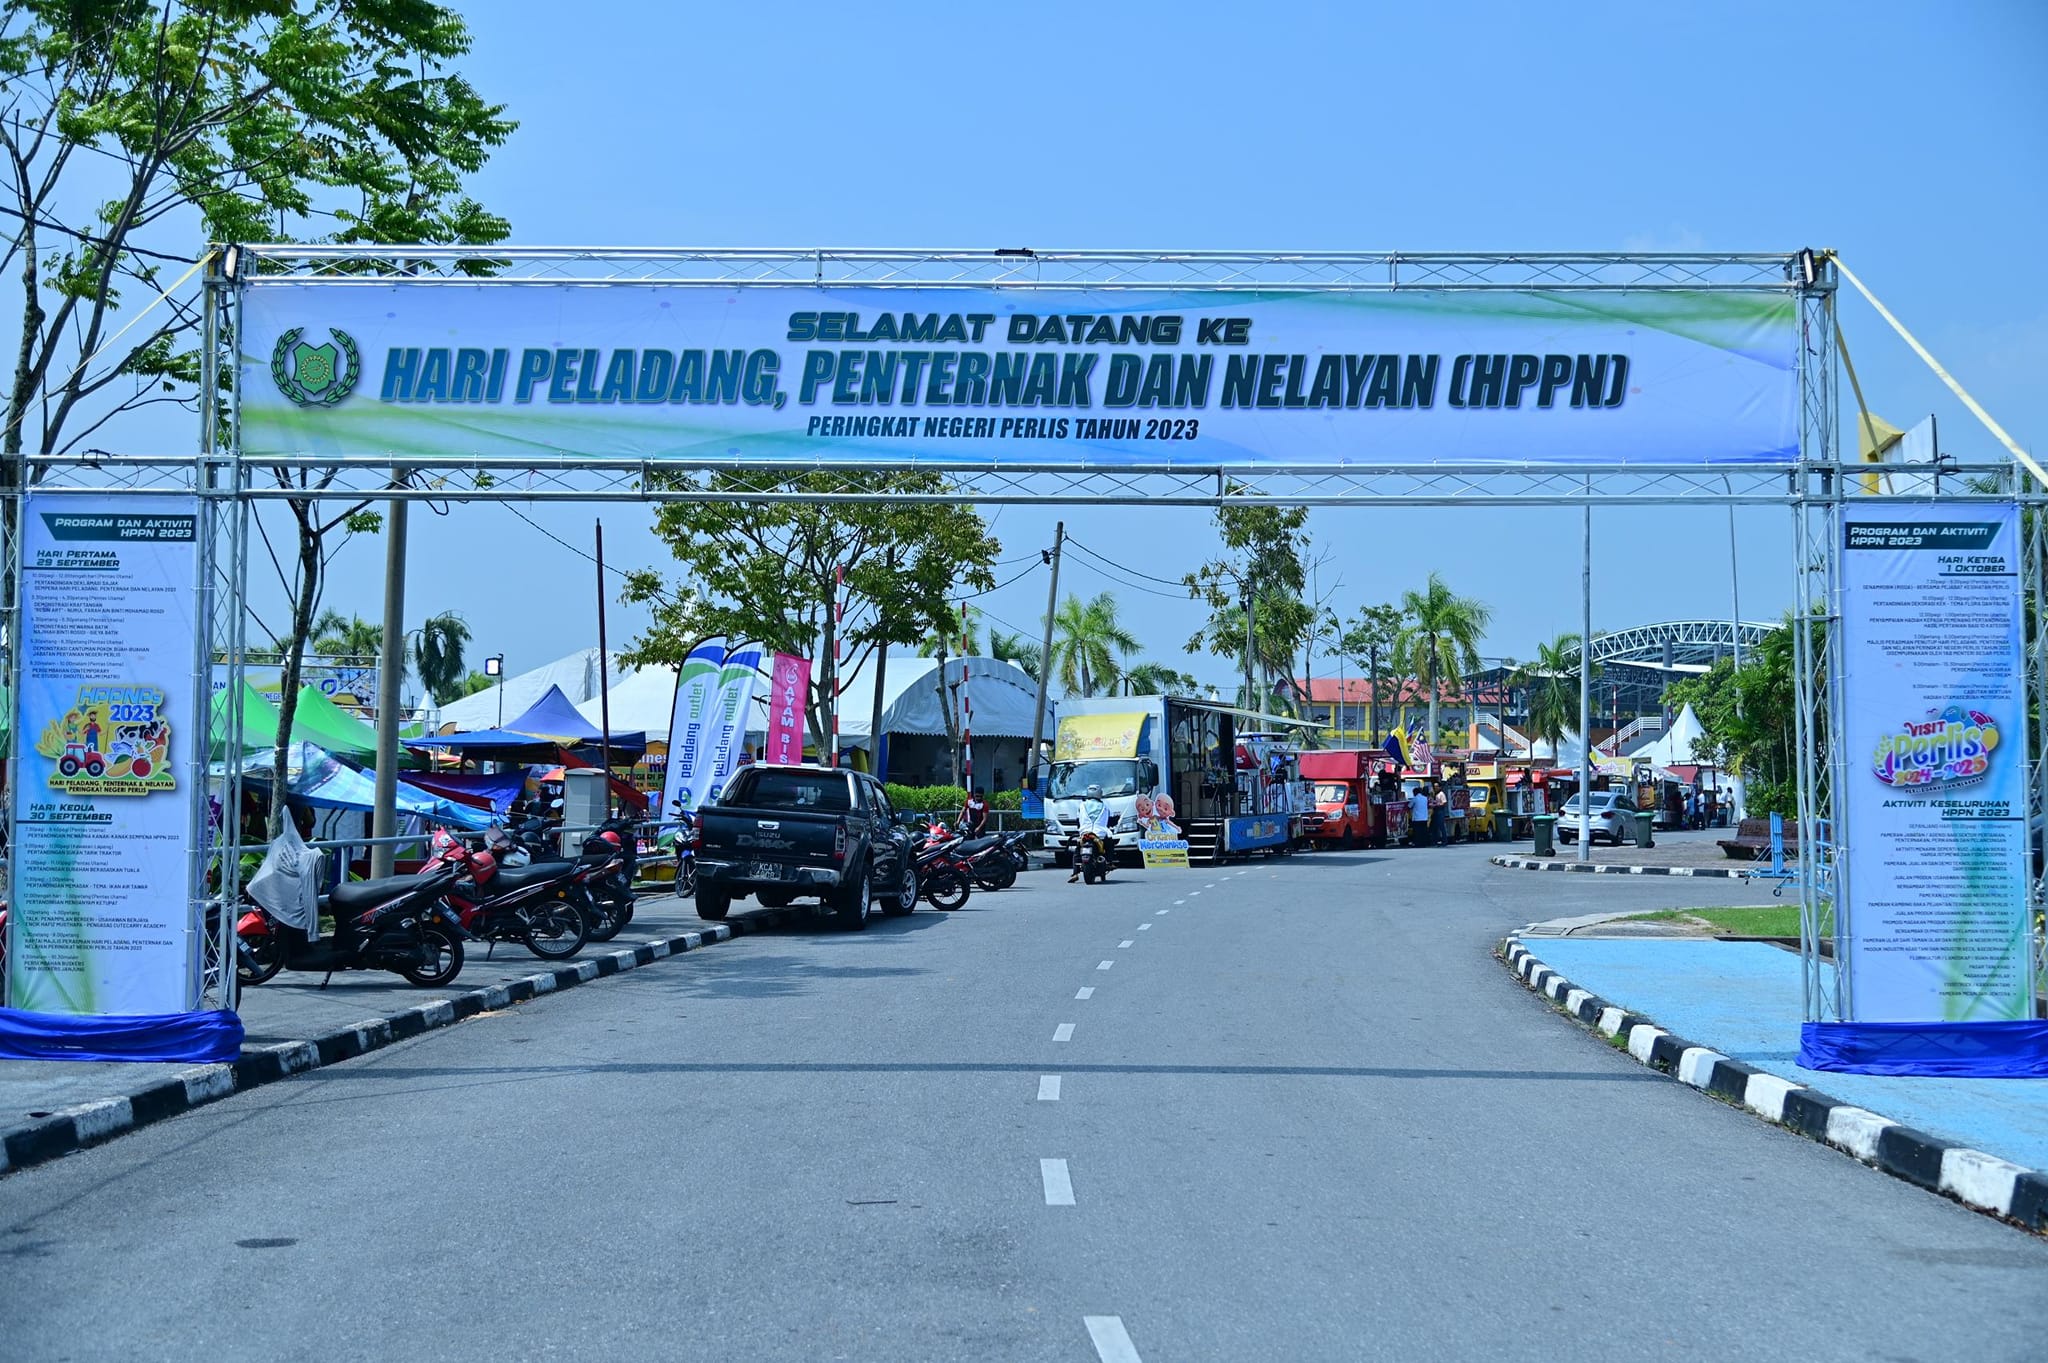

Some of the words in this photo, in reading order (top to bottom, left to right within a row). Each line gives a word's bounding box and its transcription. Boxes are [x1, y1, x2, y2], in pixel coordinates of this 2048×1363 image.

[787, 312, 995, 342] SELAMAT
[1007, 314, 1184, 343] DATANG
[1199, 318, 1251, 345] KE
[380, 346, 510, 403] HARI
[515, 347, 788, 411] PELADANG,
[800, 349, 1099, 408] PENTERNAK
[1103, 353, 1213, 409] DAN
[1220, 353, 1440, 409] NELAYAN
[1447, 353, 1630, 409] (HPPN)
[807, 415, 920, 437] PERINGKAT
[923, 416, 995, 438] NEGERI
[999, 417, 1067, 439] PERLIS
[1074, 418, 1140, 439] TAHUN
[1145, 418, 1200, 441] 2023
[55, 518, 114, 527] PROGRAM
[117, 519, 142, 528] DAN
[144, 519, 193, 528] AKTIVITI
[120, 528, 155, 537] HPPN
[158, 529, 192, 538] 2023
[1850, 527, 1909, 536] PROGRAM
[1912, 528, 1937, 536] DAN
[1850, 537, 1885, 545] HPPN
[1888, 537, 1922, 546] 2023
[36, 550, 63, 559] HARI
[66, 550, 117, 559] PERTAMA
[36, 559, 53, 567] 29
[56, 559, 120, 567] SEPTEMBER
[1937, 556, 1964, 564] HARI
[1967, 556, 2005, 564] KETIGA
[1954, 564, 2006, 573] OKTOBER
[688, 683, 704, 719] outlet
[781, 686, 795, 728] AYAM
[110, 704, 154, 721] 2023
[713, 725, 735, 778] peladang
[725, 687, 739, 721] outlet
[1903, 721, 1946, 737] VISIT
[679, 722, 701, 779] peladang
[30, 803, 56, 811] HARI
[60, 804, 95, 812] KEDUA
[1882, 800, 1926, 808] AKTIVITI
[1930, 800, 2010, 808] KESELURUHAN
[29, 811, 45, 820] 30
[49, 812, 113, 820] SEPTEMBER
[1941, 808, 1974, 816] HPPN
